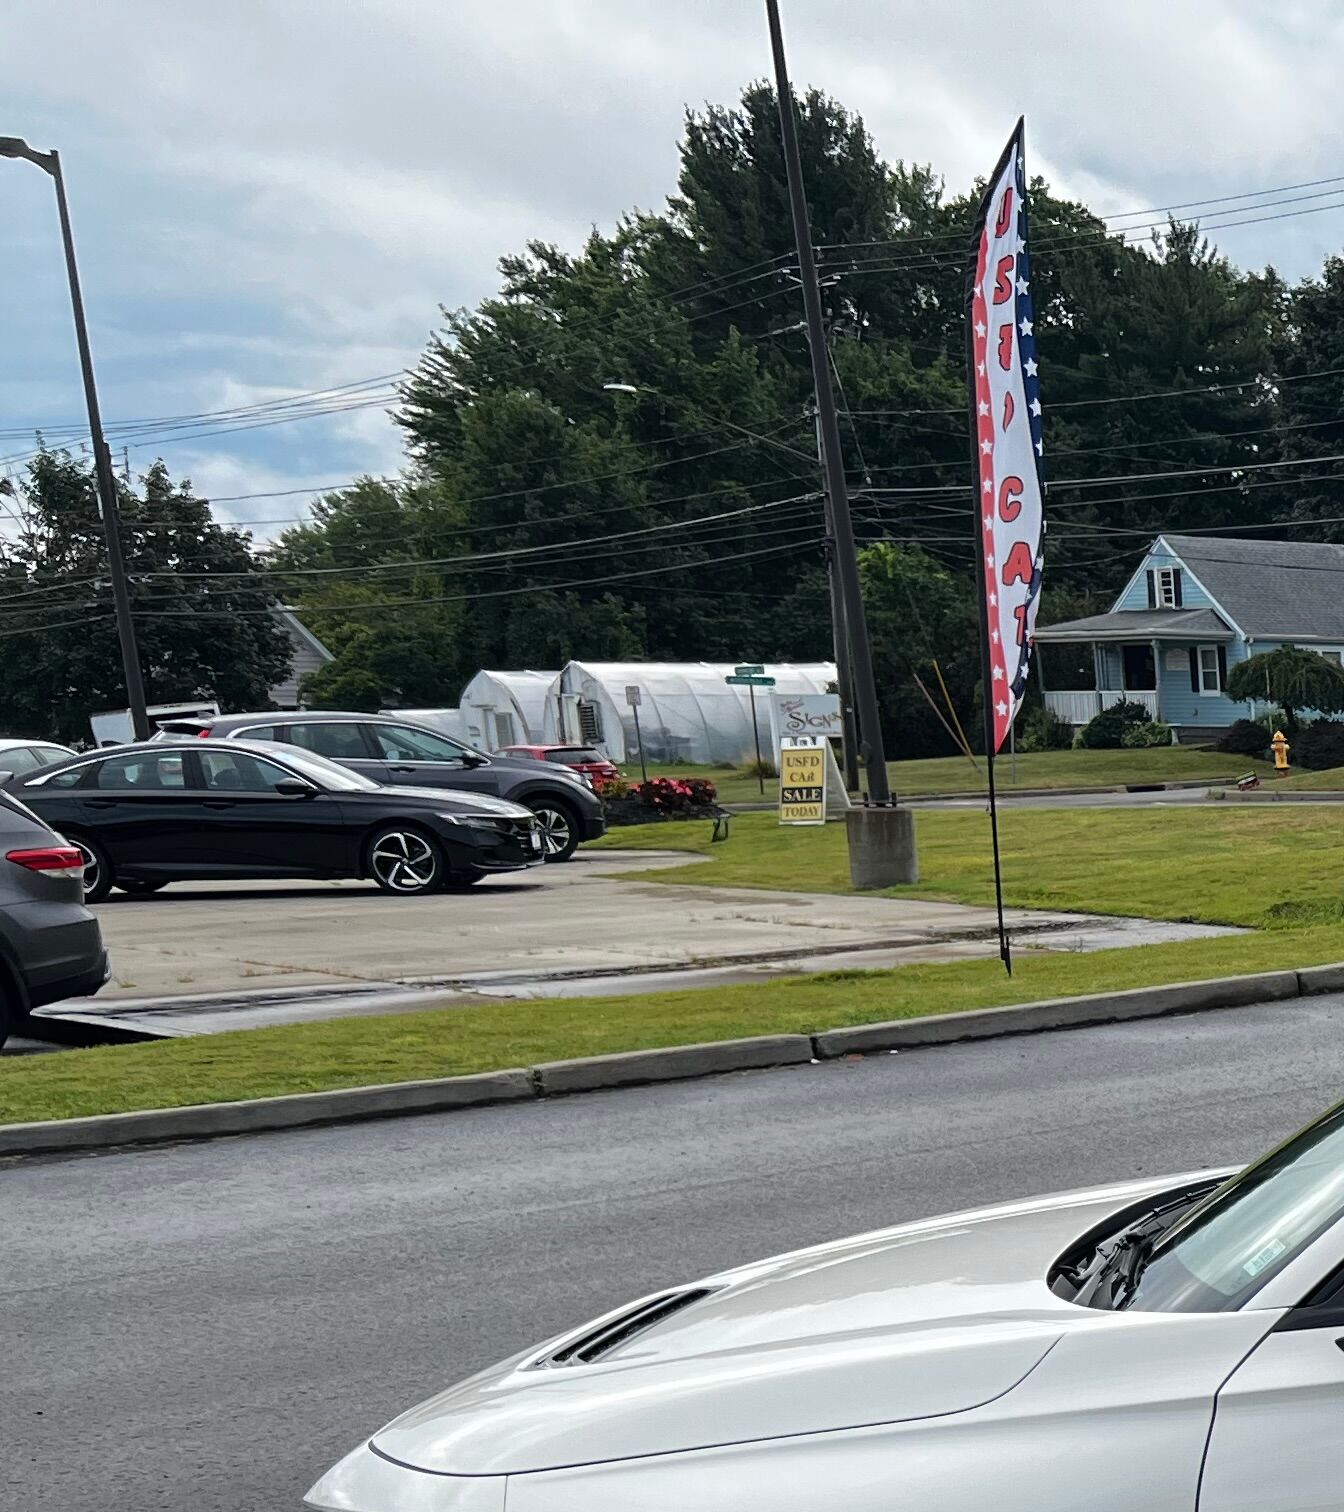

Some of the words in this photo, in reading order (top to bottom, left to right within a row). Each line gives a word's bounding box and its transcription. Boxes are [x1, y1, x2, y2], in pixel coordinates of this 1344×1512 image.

[790, 772, 815, 782] CAR
[783, 789, 821, 801] SALE
[784, 806, 819, 817] TODAY
